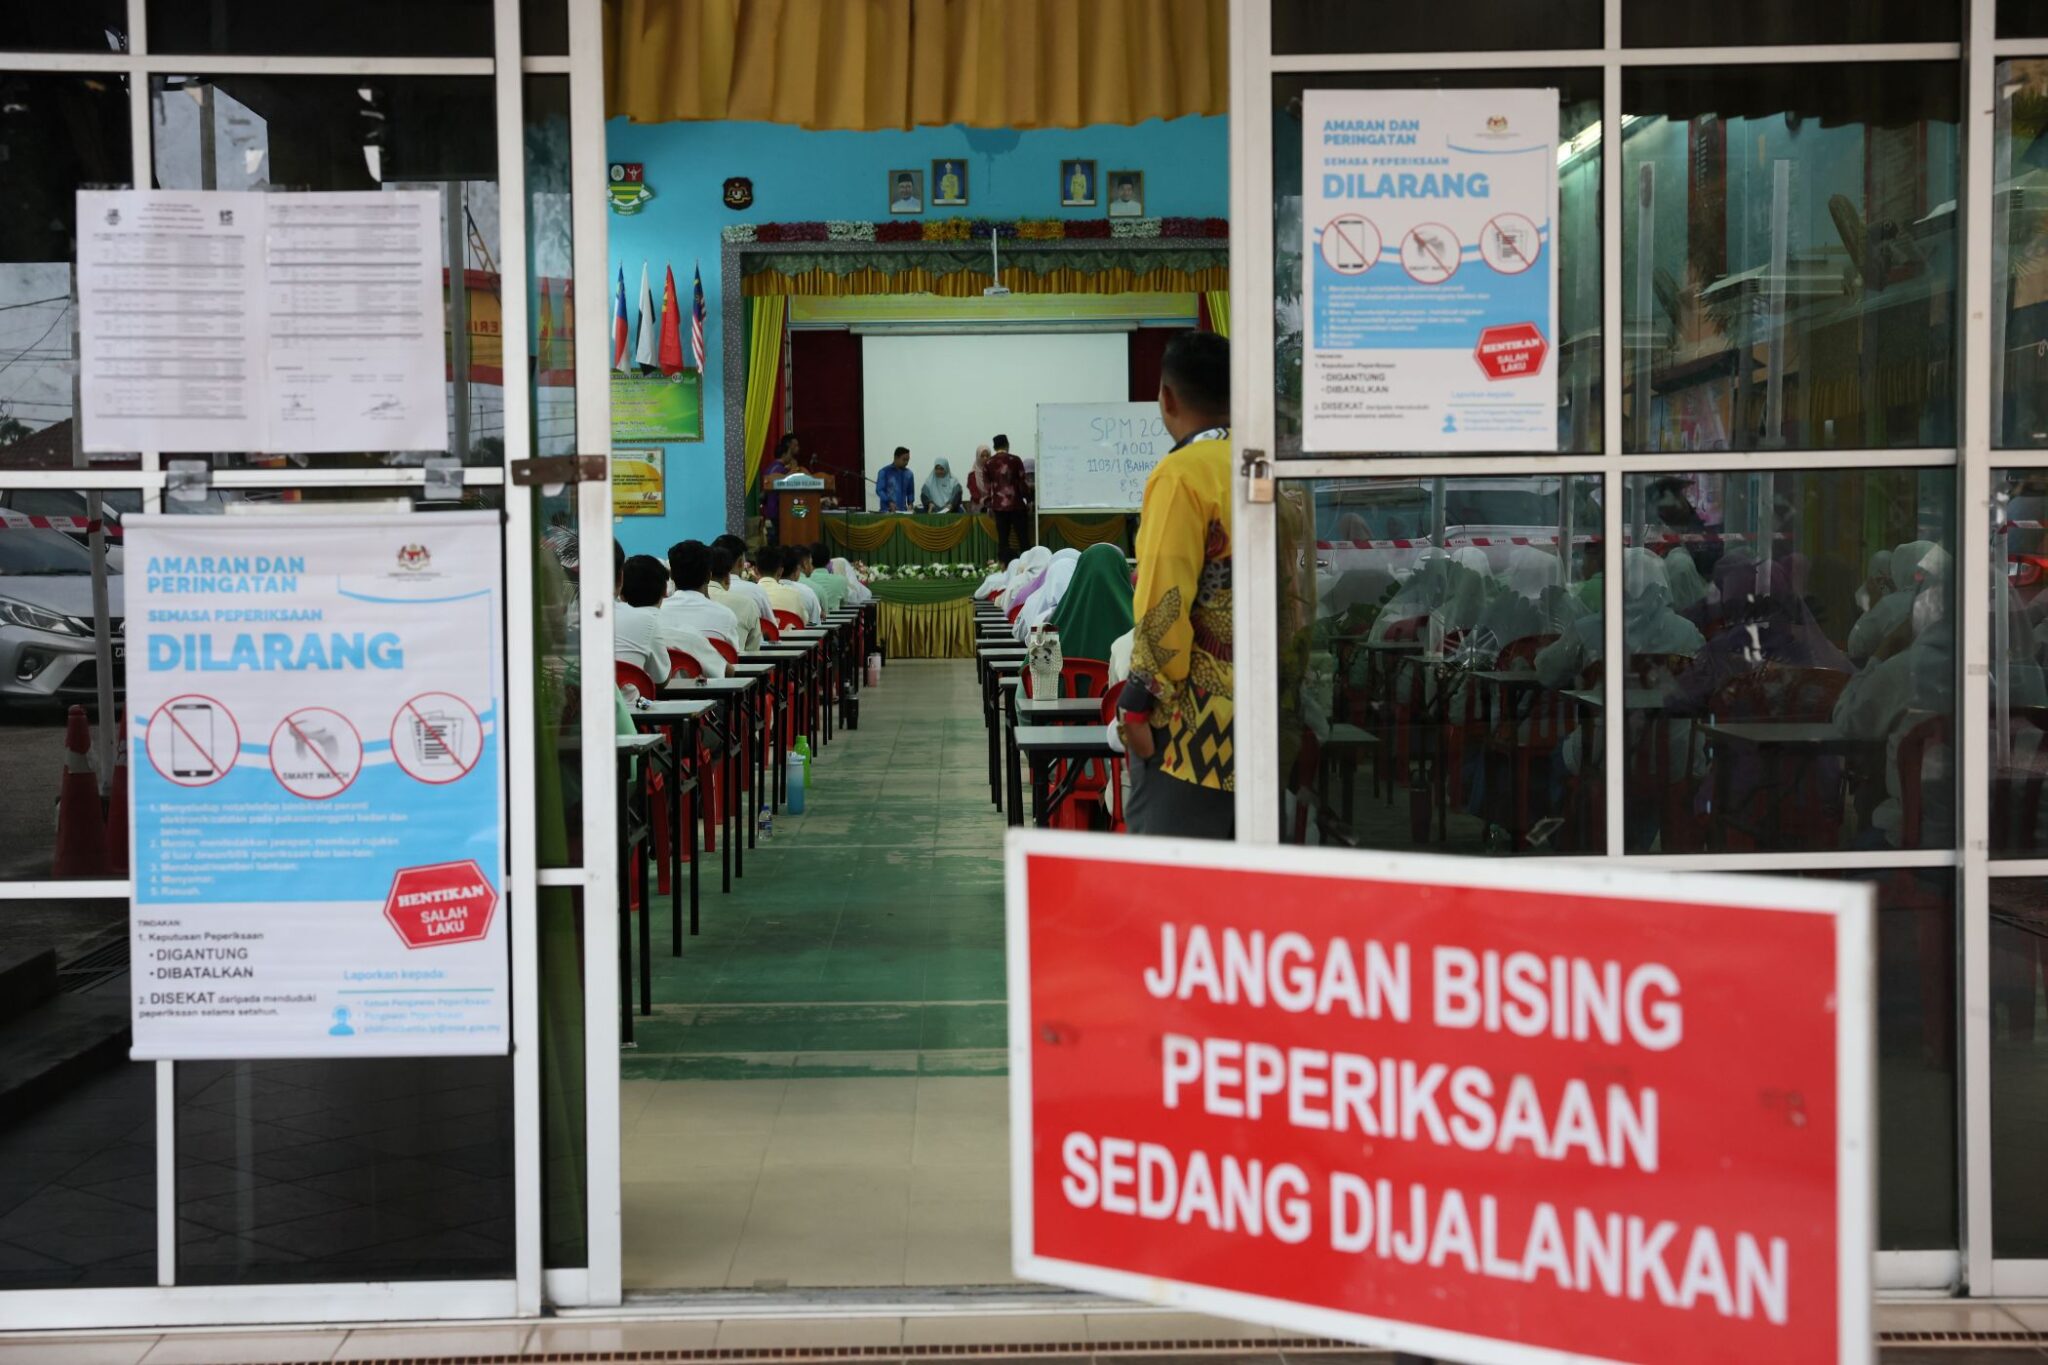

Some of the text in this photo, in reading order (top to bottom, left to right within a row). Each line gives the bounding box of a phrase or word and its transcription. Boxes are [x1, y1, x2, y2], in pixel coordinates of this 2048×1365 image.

[1323, 120, 1420, 132] AMARAN DAN
[1324, 134, 1416, 145] PERINGATAN
[1324, 157, 1449, 166] SEMASA PEPERIKSAAN
[1322, 173, 1490, 199] DILARANG
[1482, 338, 1540, 354] HENTIKAN
[1497, 352, 1529, 364] SALAH
[1501, 362, 1526, 373] LAKU
[1326, 373, 1385, 382] DIGANTUNG
[1326, 385, 1389, 395] DIBATALKAN
[1321, 401, 1363, 411] DISEKAT
[1090, 417, 1169, 442] SPM 20
[147, 556, 305, 575] AMARAN DAN
[148, 576, 298, 594] PERINGATAN
[148, 609, 323, 623] SEMASA PEPERIKSAAN
[148, 632, 404, 672] DILARANG
[282, 772, 313, 781] SMART
[397, 884, 485, 908] HENTIKAN
[420, 907, 468, 924] SALAH
[427, 920, 465, 937] LAKU
[204, 931, 264, 942] Peperiksaan
[157, 948, 248, 961] DIGANTUNG
[157, 966, 254, 979] DIBATALKAN
[343, 969, 398, 981] Laporkan
[1144, 922, 1682, 1051] JANGAN BISING
[150, 992, 215, 1005] DISEKAT
[1163, 1032, 1659, 1172] PEPERIKSAAN
[1061, 1130, 1789, 1326] SEDANG DIJALANKAN
